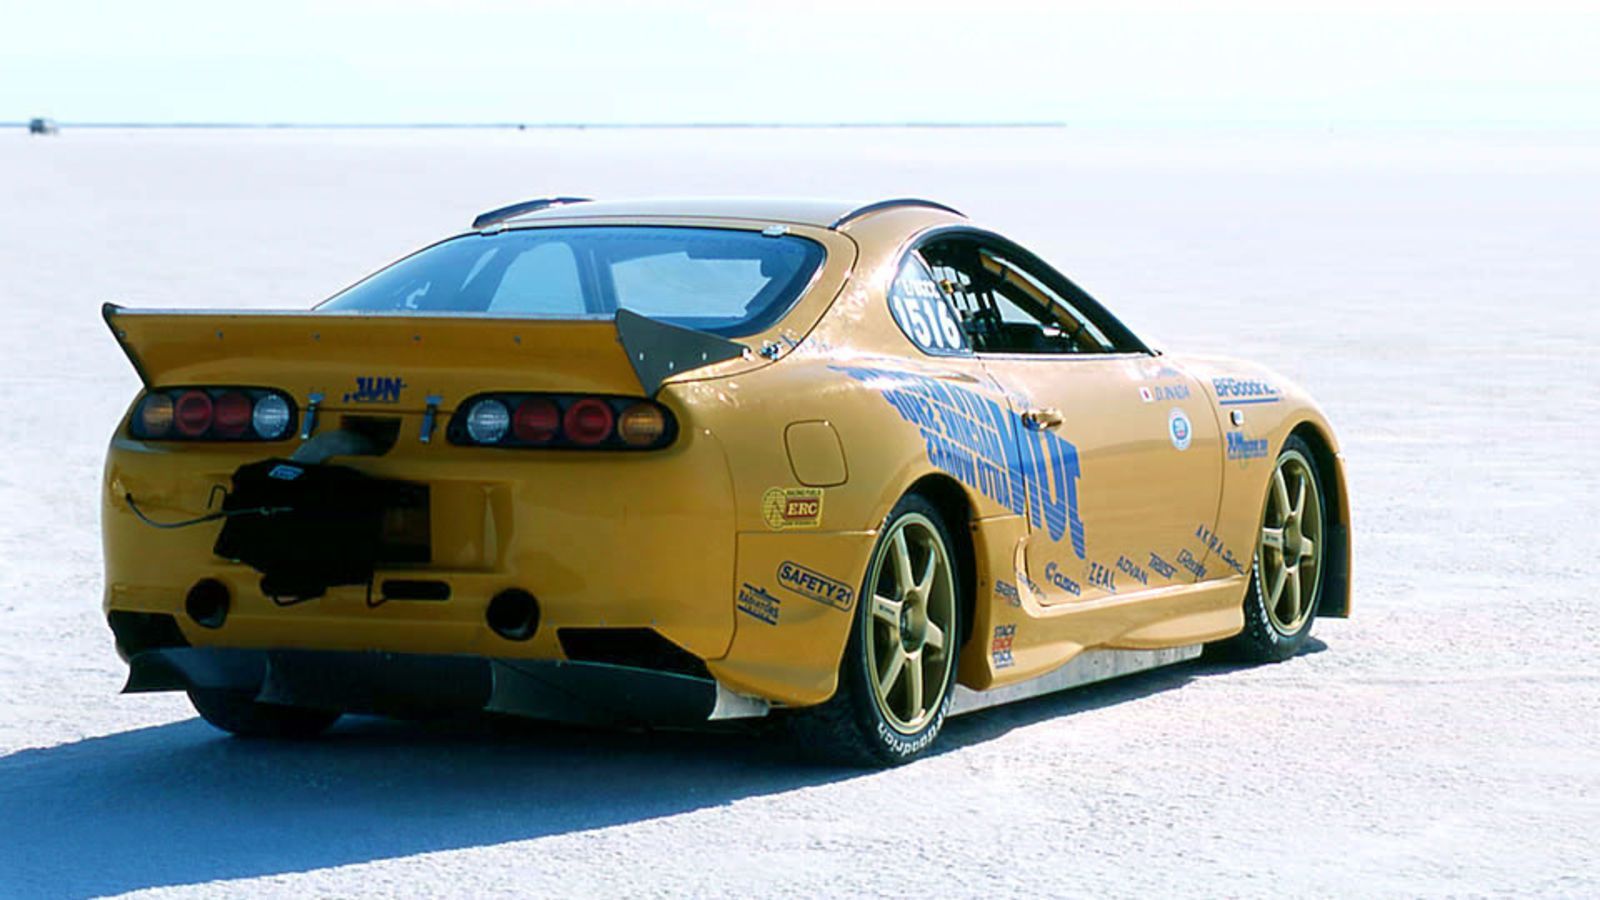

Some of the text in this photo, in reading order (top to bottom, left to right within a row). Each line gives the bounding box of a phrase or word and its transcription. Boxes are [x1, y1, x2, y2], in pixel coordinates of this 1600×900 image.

[892, 295, 961, 350] 1516
[342, 376, 402, 402] JUN
[787, 502, 818, 516] ERC
[1088, 562, 1117, 592] ZEAL
[1116, 554, 1148, 585] ADVAN
[781, 565, 837, 597] SAFETY
[836, 588, 852, 605] 21
[994, 623, 1016, 638] STACK
